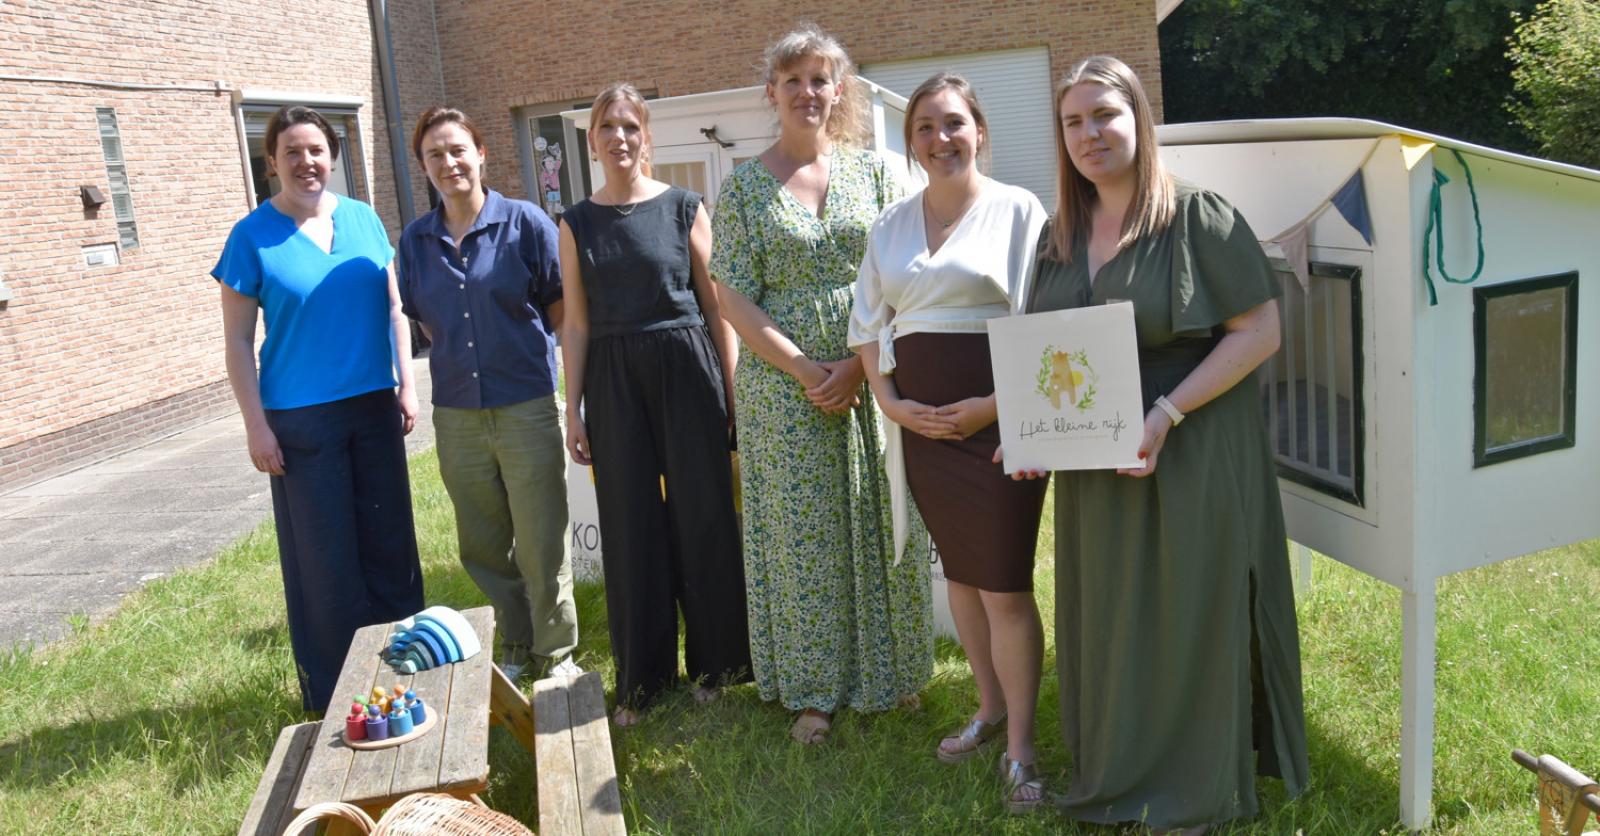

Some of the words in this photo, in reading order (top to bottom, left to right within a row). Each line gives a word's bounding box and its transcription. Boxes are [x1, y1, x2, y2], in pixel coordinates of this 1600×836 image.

[1019, 419, 1048, 440] Het
[1054, 417, 1097, 433] kleine
[1102, 411, 1127, 441] rijk
